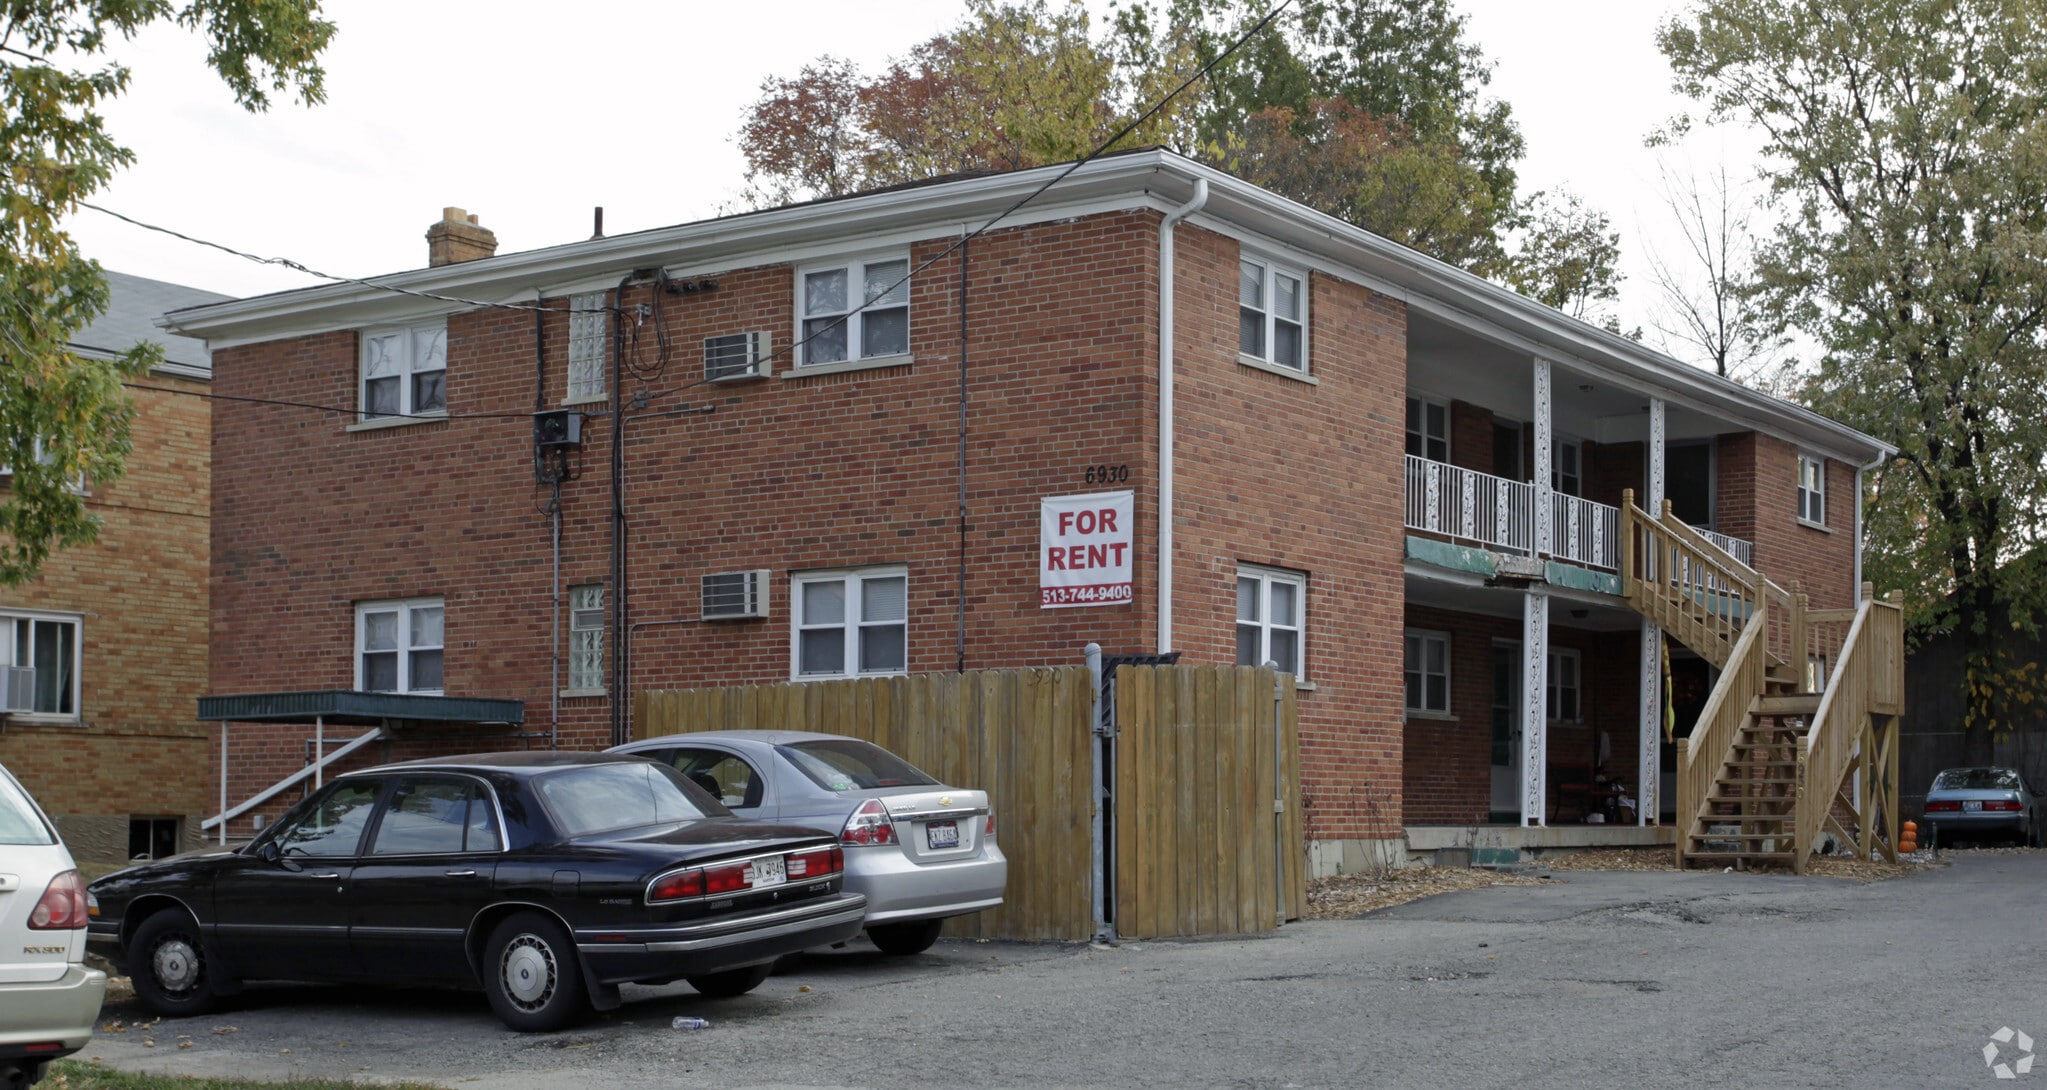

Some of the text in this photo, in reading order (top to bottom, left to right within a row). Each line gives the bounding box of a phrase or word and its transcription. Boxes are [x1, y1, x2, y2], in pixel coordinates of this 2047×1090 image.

[1085, 465, 1128, 484] 6930
[1059, 508, 1118, 536] FOR
[1048, 542, 1128, 571] RENT
[1042, 585, 1132, 603] 513-744-9400
[23, 946, 41, 954] RX
